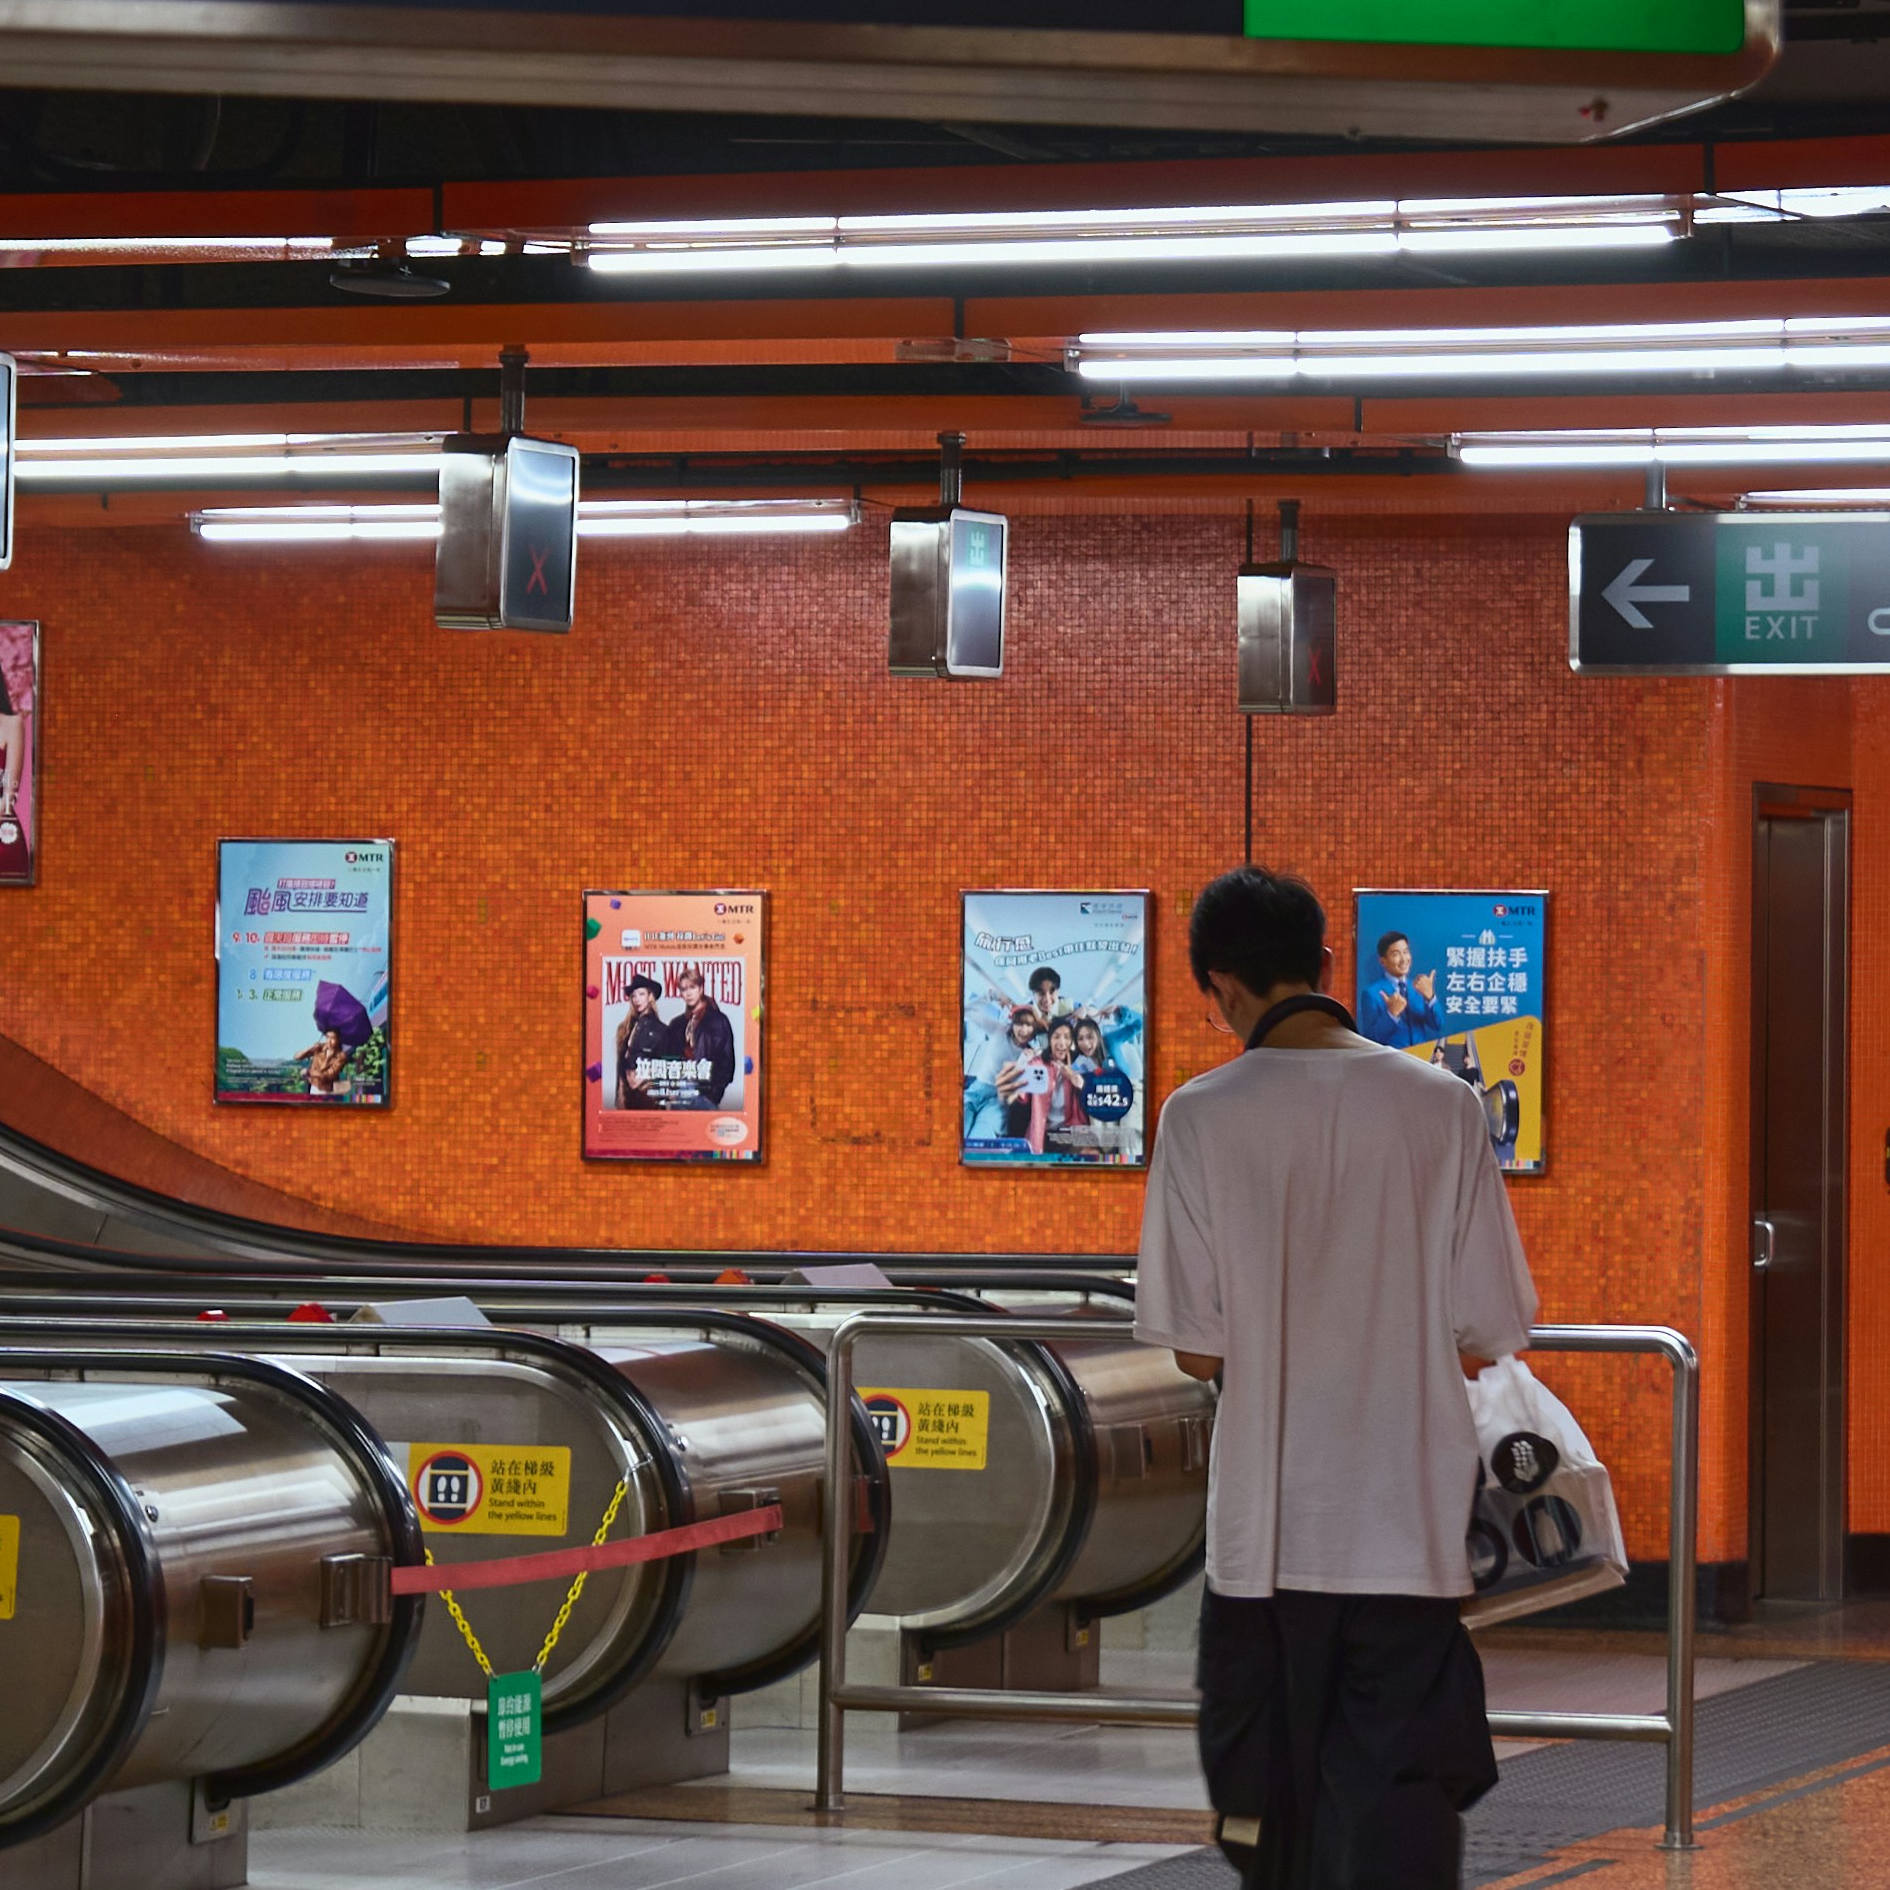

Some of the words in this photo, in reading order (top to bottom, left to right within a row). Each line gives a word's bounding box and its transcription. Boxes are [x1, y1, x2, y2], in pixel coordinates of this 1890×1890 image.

[1745, 542, 1819, 611] 出
[1745, 616, 1819, 639] EXIT
[358, 853, 384, 863] MTR
[727, 905, 754, 914] MTR
[1508, 905, 1536, 916] MTR
[1446, 947, 1528, 968] 緊握扶手
[662, 961, 742, 1006] WNTED
[1446, 972, 1527, 993] 左右企穩
[1445, 996, 1518, 1015] 安全要緊
[916, 1436, 940, 1445] Stand
[942, 1437, 966, 1445] within
[915, 1447, 930, 1455] the
[930, 1447, 957, 1457] yellow
[958, 1448, 977, 1457] lines
[490, 1460, 555, 1477] 站在梯級
[489, 1498, 515, 1508] Stand
[517, 1500, 545, 1509] within
[488, 1512, 503, 1521] the
[504, 1512, 535, 1522] yellow
[536, 1512, 557, 1522] lines
